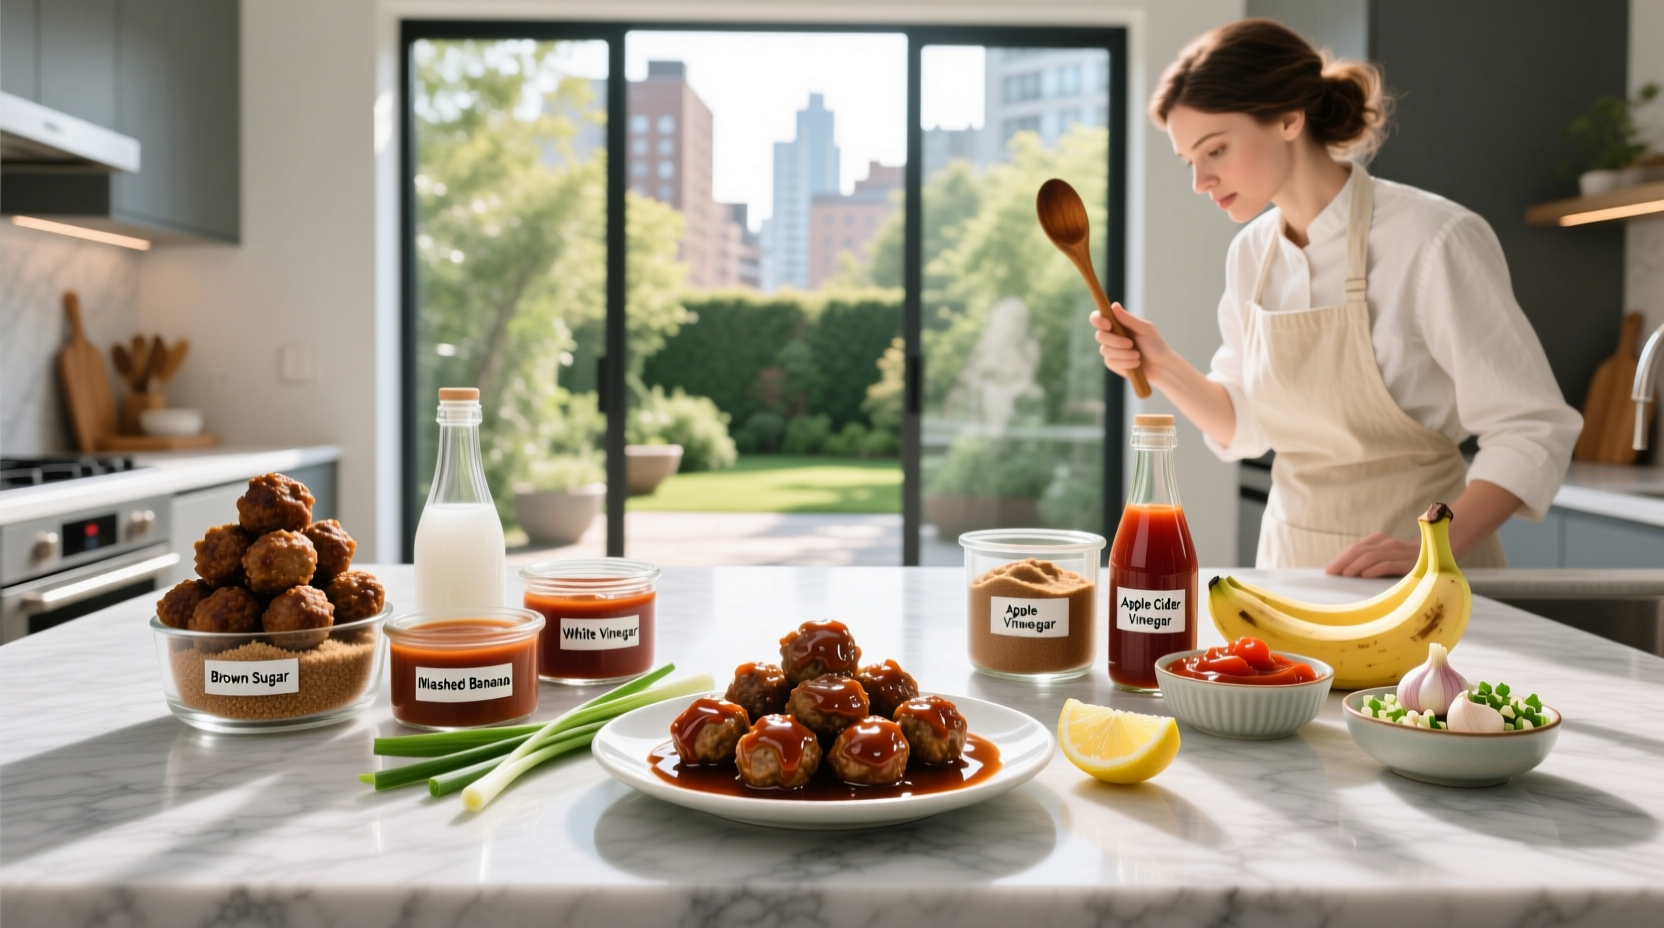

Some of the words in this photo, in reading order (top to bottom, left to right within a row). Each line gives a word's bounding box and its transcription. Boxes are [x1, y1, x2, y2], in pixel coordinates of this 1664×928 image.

[1120, 596, 1152, 612] Apple
[1153, 597, 1183, 611] Cider
[1128, 612, 1172, 630] Vinegar
[562, 626, 597, 641] White
[599, 626, 639, 642] Vinegar
[210, 670, 249, 685] Brown
[252, 671, 290, 688] Sugar
[418, 676, 466, 691] Mashed
